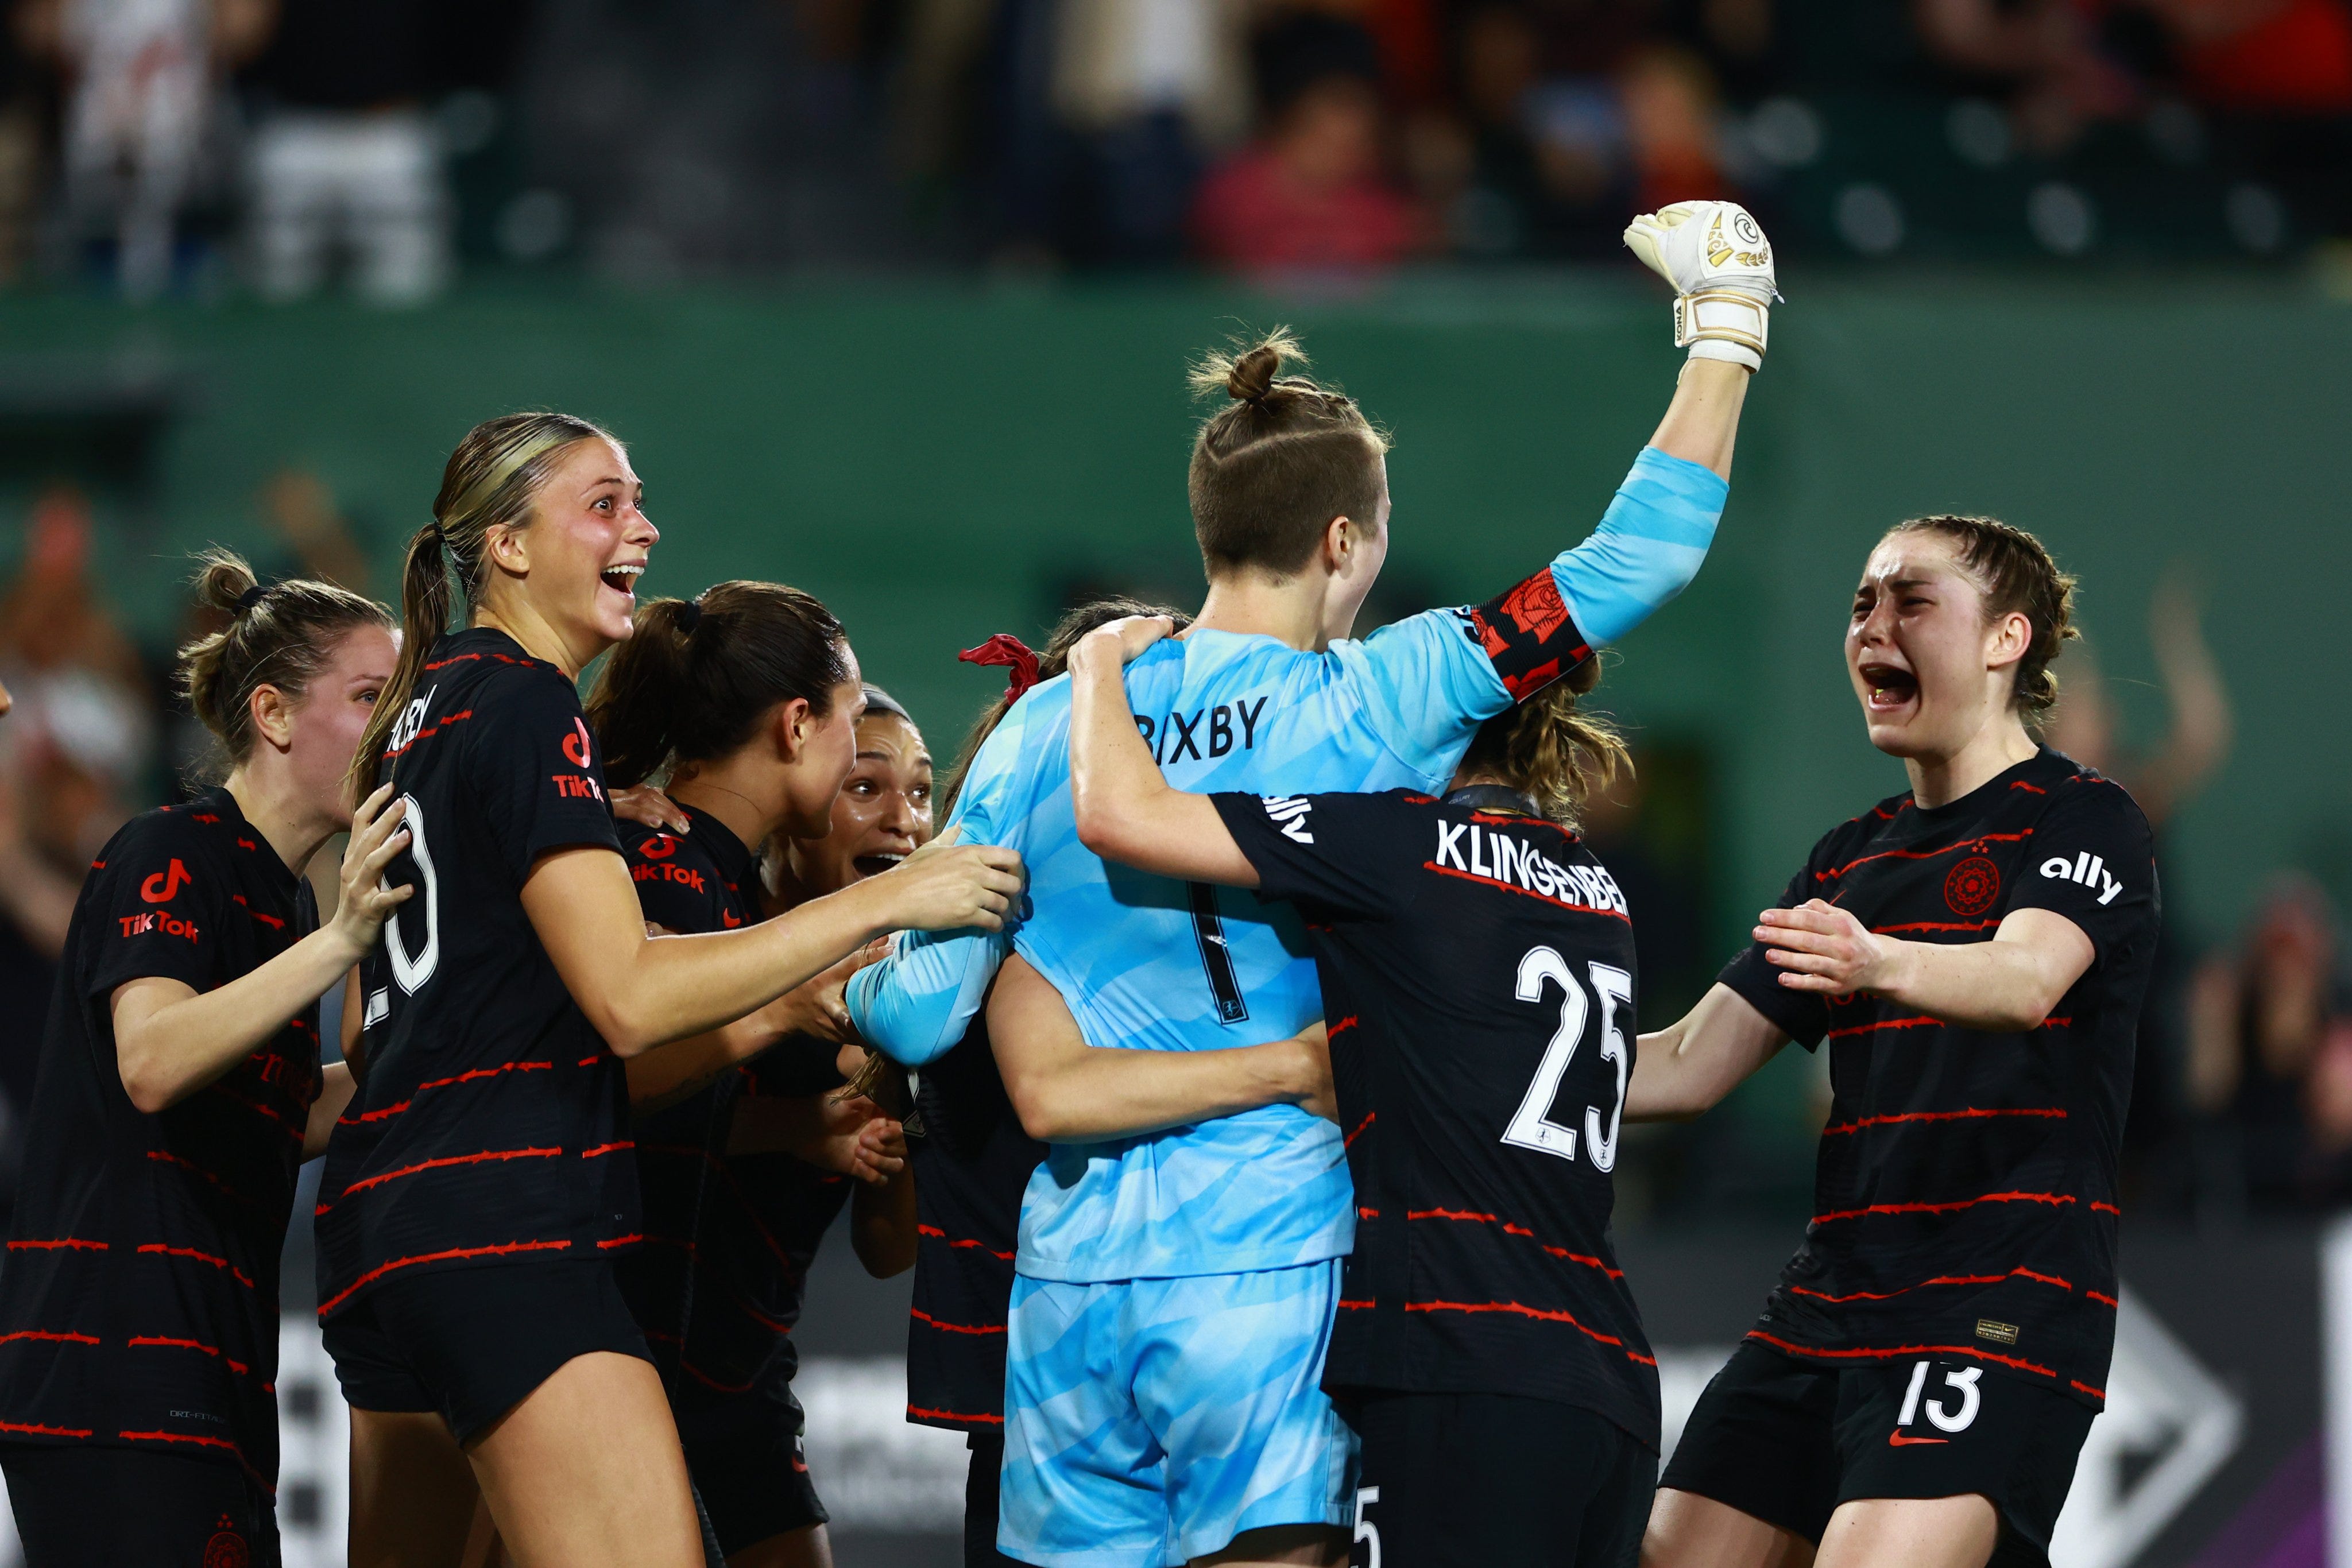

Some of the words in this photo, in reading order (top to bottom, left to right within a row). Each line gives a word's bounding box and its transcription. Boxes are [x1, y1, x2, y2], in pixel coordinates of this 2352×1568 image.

[1134, 696, 1269, 766] BIXBY
[629, 863, 705, 895] ikTok
[2040, 851, 2123, 905] ally
[119, 910, 199, 944] TikTok
[1499, 945, 1632, 1173] 25
[1898, 1360, 1983, 1433] 13
